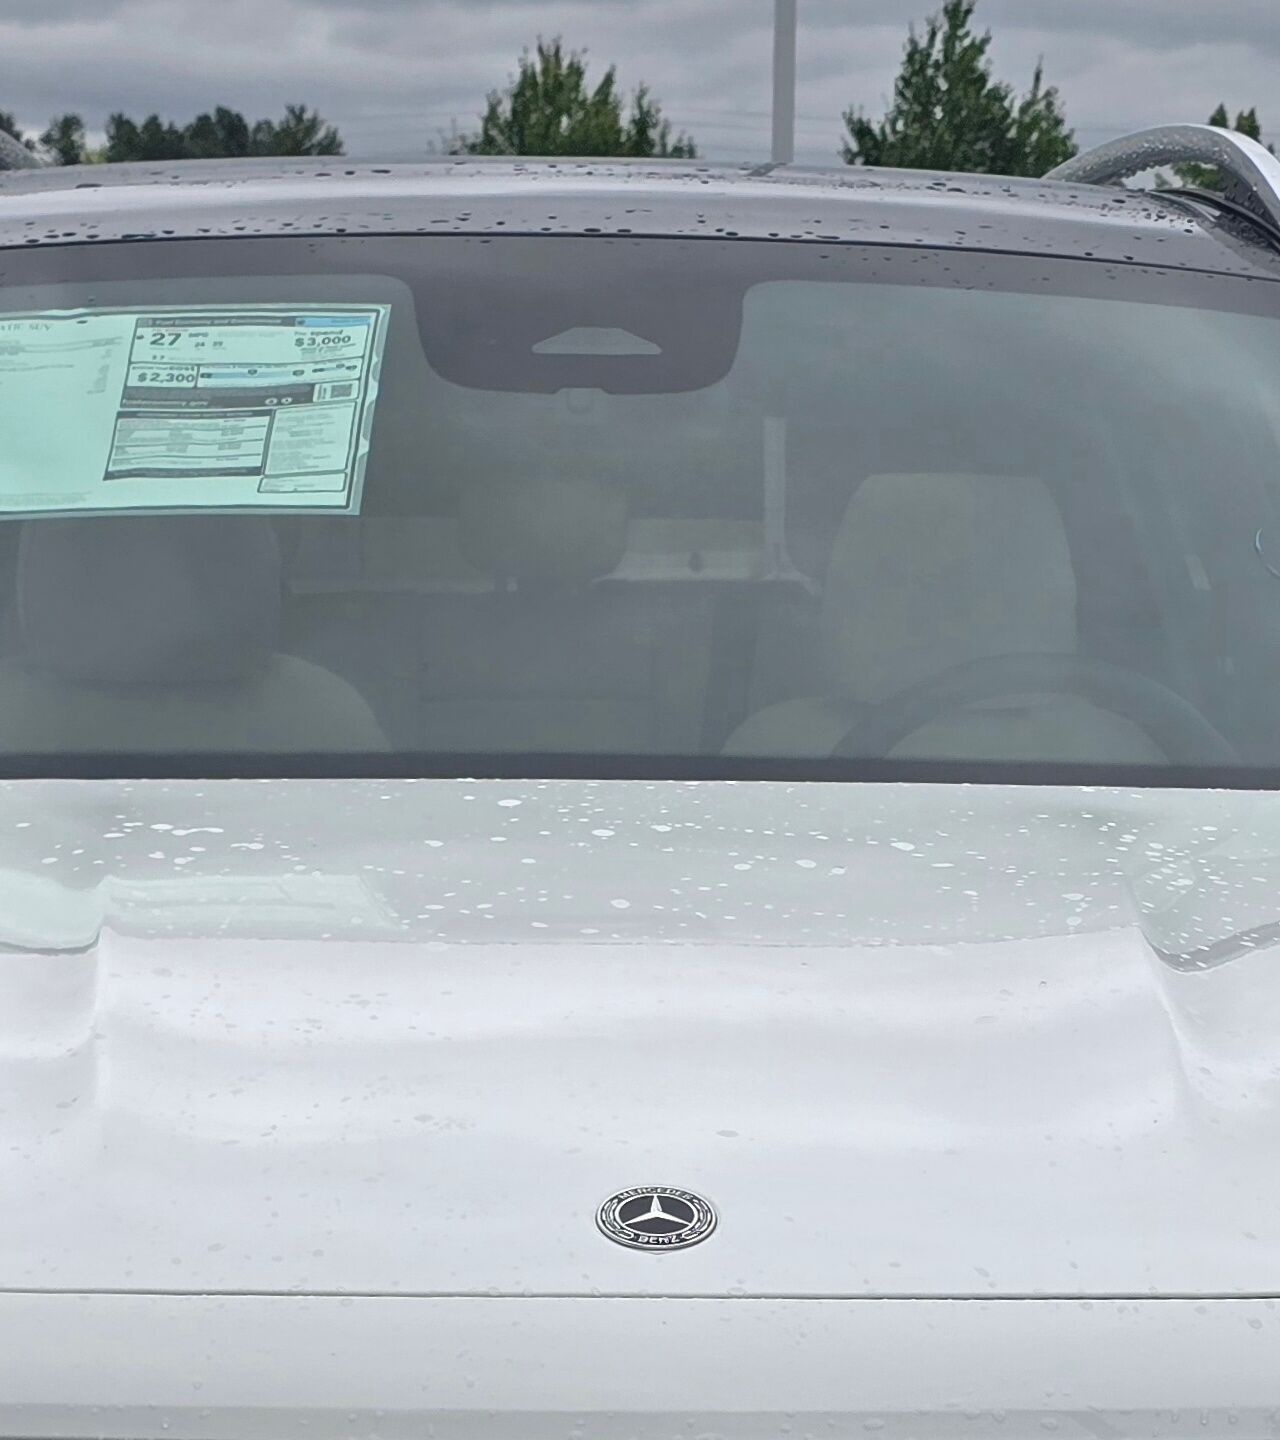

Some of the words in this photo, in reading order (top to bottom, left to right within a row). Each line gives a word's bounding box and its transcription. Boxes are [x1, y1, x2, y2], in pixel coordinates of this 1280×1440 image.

[150, 332, 182, 346] 27
[294, 335, 352, 348] $3,000
[137, 372, 196, 383] $2,300
[637, 1235, 680, 1245] BENZ
